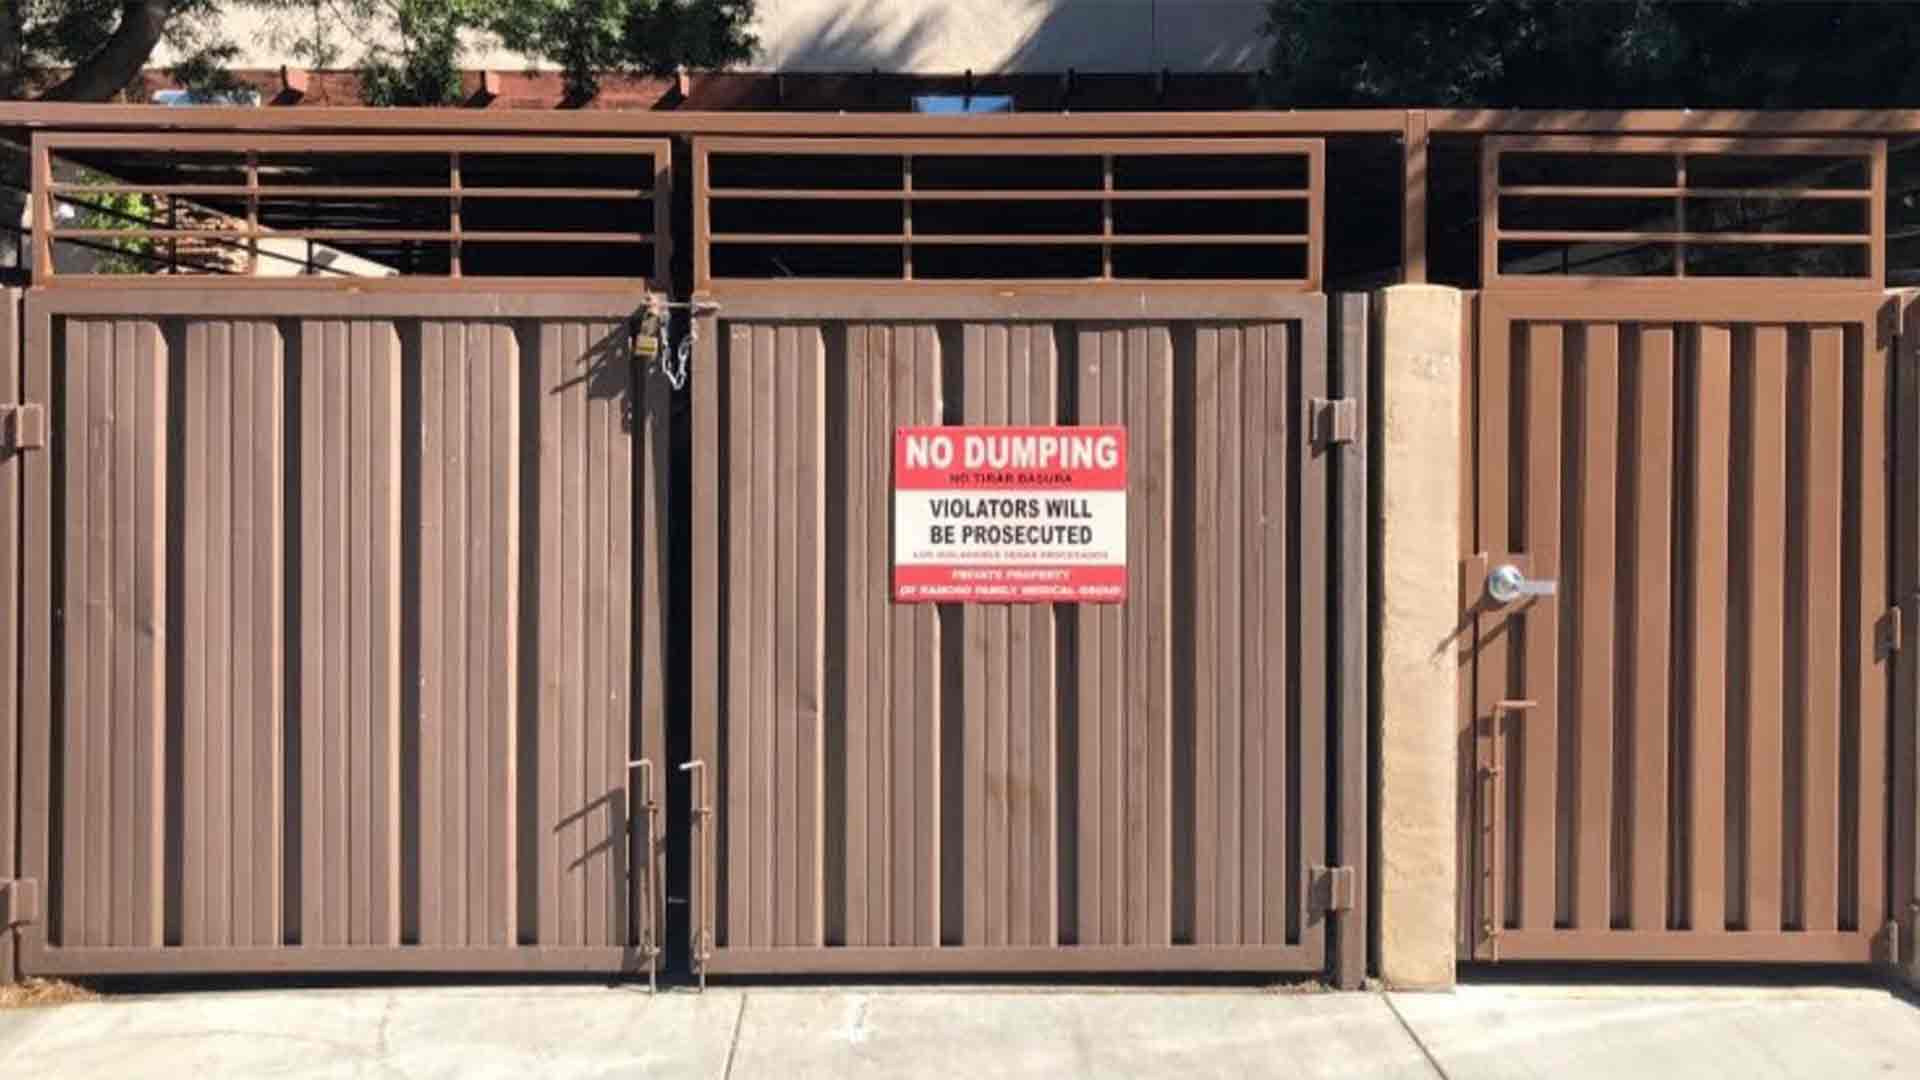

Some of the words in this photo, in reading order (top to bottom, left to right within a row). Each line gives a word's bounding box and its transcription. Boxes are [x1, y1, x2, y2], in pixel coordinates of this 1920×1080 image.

[906, 435, 953, 470] NO
[964, 435, 1118, 470] DUMPING
[949, 472, 968, 484] NO
[929, 498, 1039, 518] VIOLATORS
[1045, 498, 1092, 518] WILL
[930, 525, 956, 545] BE
[962, 525, 1092, 545] PROSECUTED
[952, 569, 1003, 580] PRIVATE
[1006, 569, 1070, 580] PROPERTY
[900, 585, 916, 595] OF
[975, 585, 1018, 595] FAMILY
[1021, 585, 1074, 595] MEDICAL
[1078, 585, 1121, 595] GROUP
